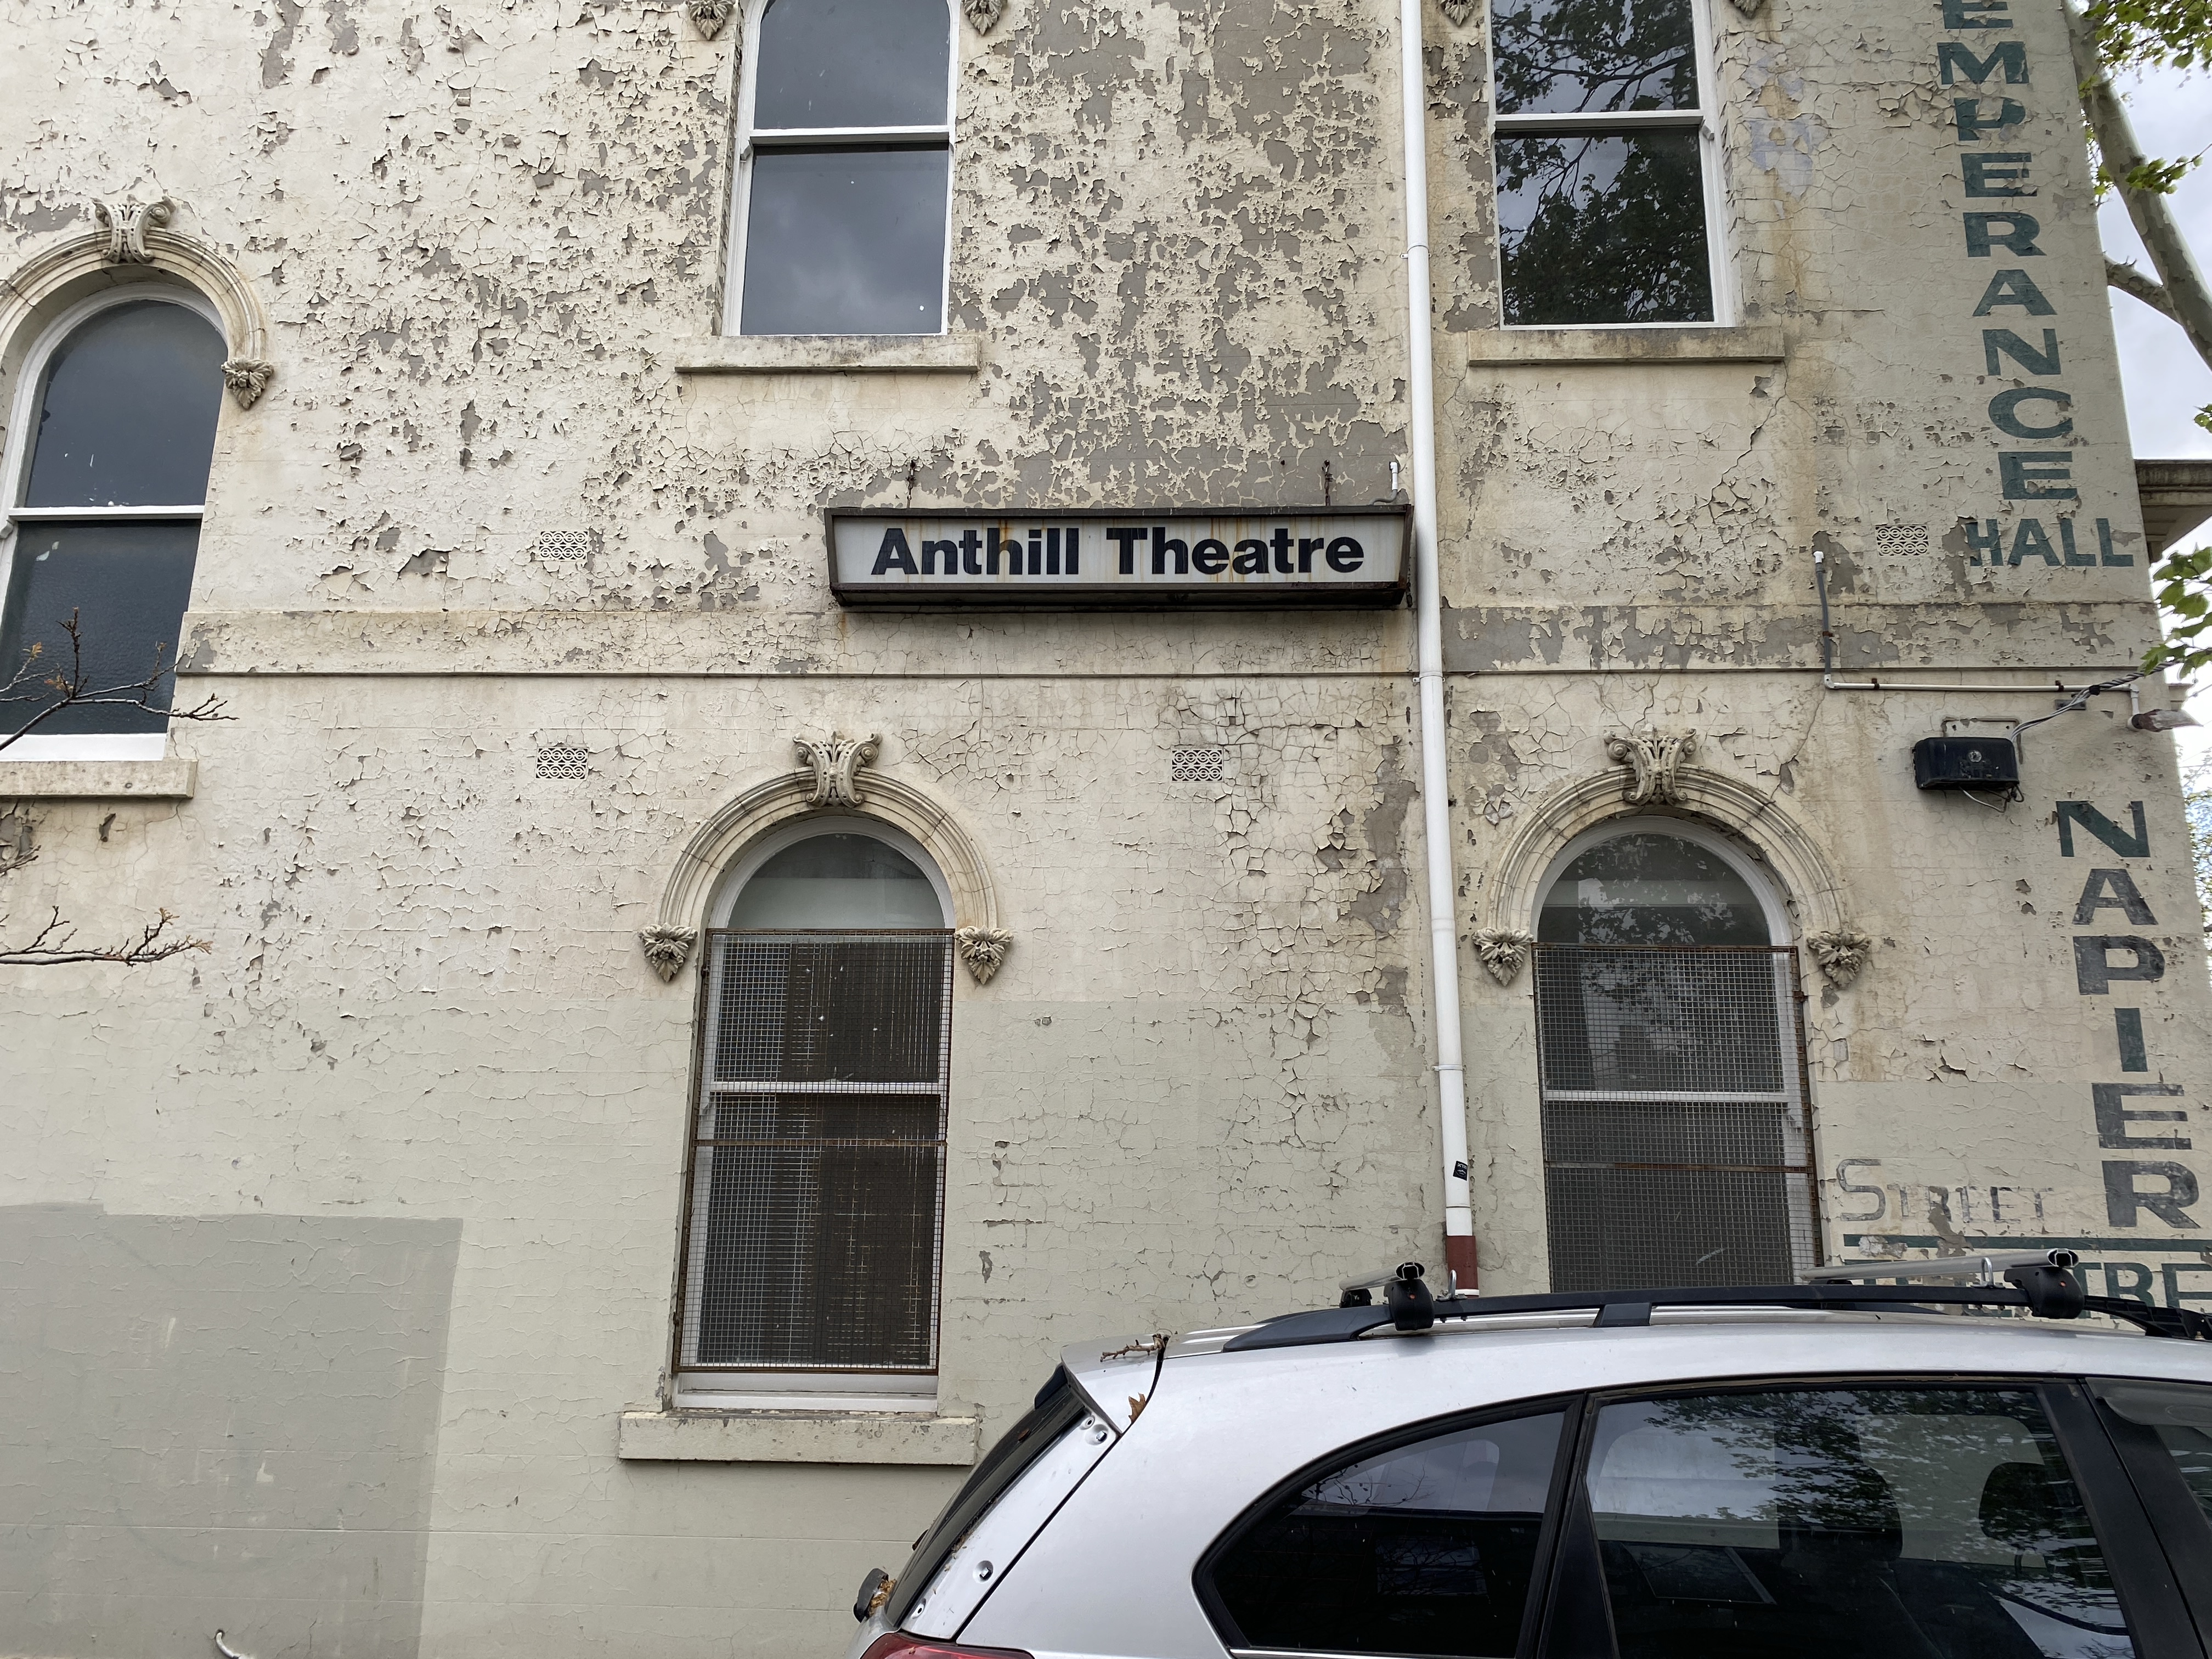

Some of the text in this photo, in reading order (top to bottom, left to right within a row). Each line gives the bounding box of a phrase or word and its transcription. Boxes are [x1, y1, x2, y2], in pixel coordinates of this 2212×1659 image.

[871, 527, 1363, 575] Anthill Theatre
[1965, 518, 2134, 566] HALL
[2055, 800, 2200, 1228] NAPIER
